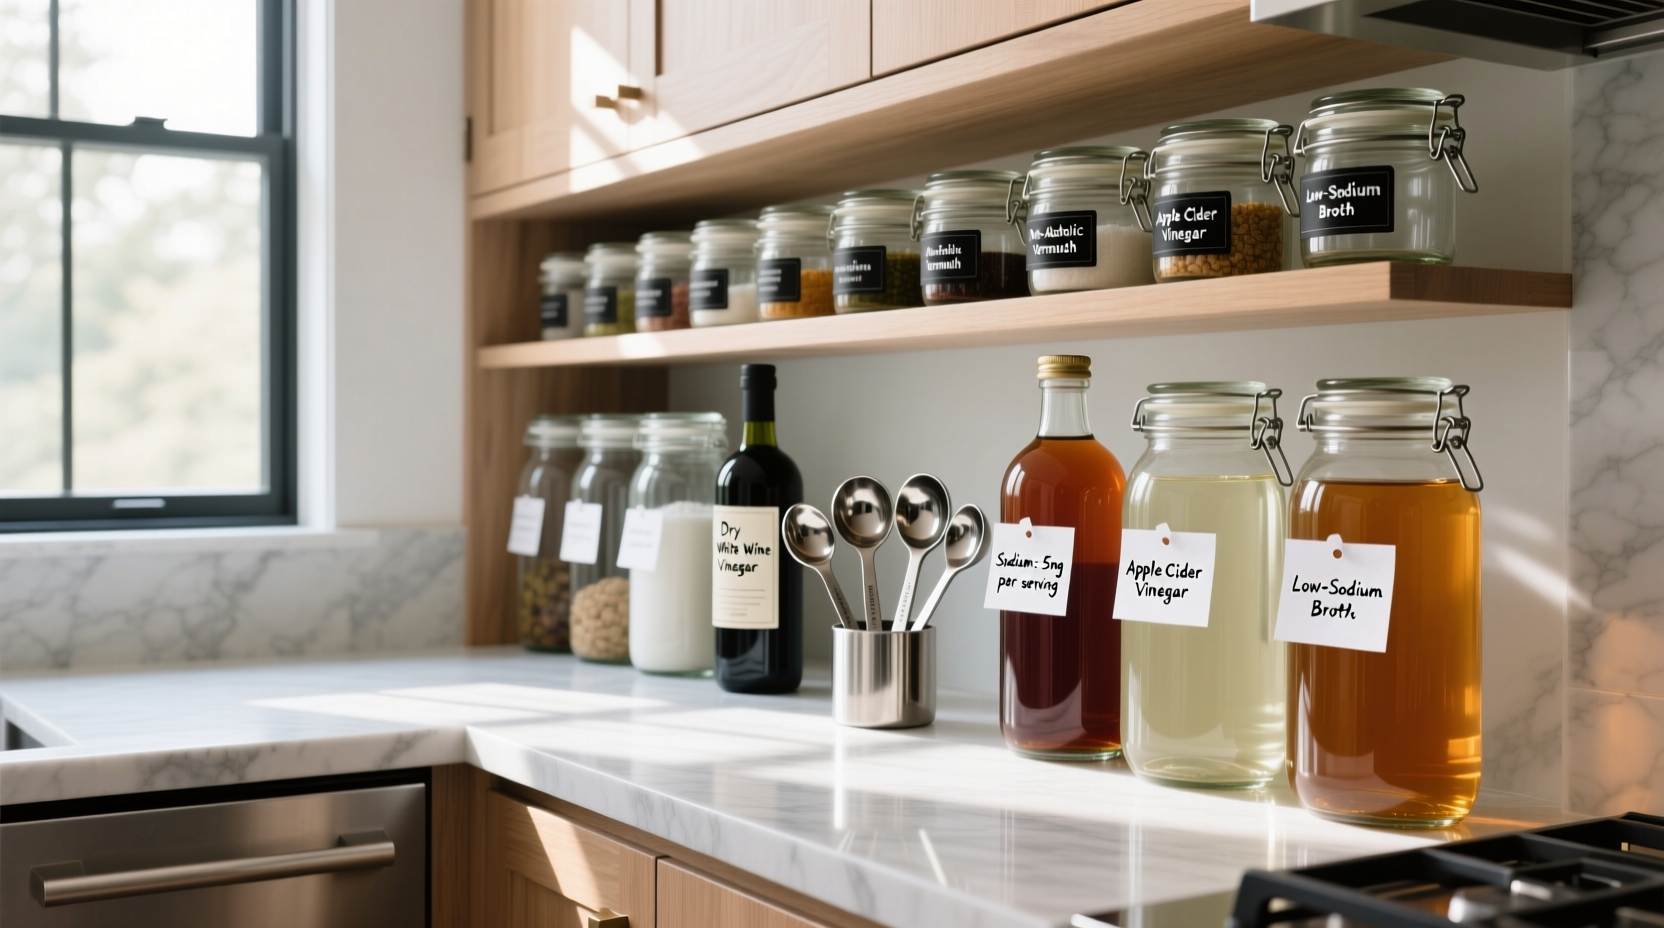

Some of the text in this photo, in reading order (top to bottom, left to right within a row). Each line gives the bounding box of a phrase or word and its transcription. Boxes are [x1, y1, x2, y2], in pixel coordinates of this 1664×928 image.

[1184, 206, 1218, 222] Cider
[1318, 202, 1355, 219] Broth
[1161, 227, 1207, 243] Vinegar
[721, 521, 741, 541] Dry
[743, 542, 772, 556] Wine
[1126, 559, 1203, 581] Apple Cider
[997, 576, 1059, 598] per serving
[1135, 582, 1189, 605] Vinegar
[1292, 574, 1383, 598] Low-Sodium
